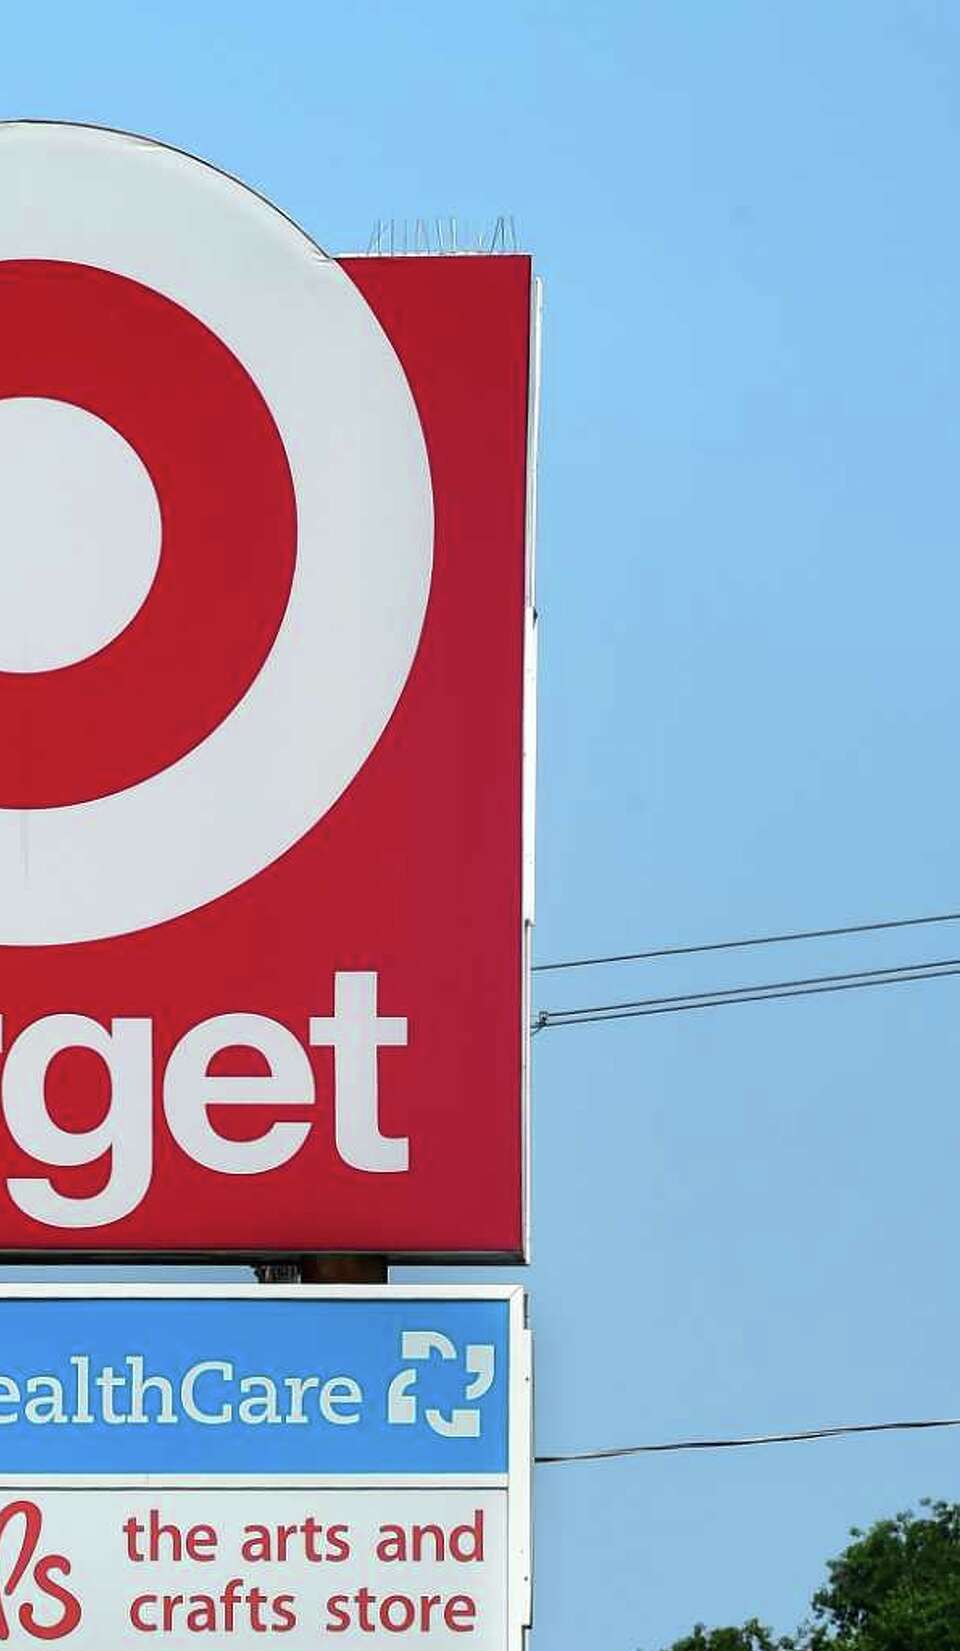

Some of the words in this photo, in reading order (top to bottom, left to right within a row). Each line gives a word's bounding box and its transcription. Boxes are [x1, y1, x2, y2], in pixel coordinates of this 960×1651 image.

[124, 1511, 218, 1563] the
[240, 1519, 352, 1564] arts
[375, 1510, 486, 1563] and
[129, 1577, 297, 1633] crafts
[327, 1588, 476, 1634] store
